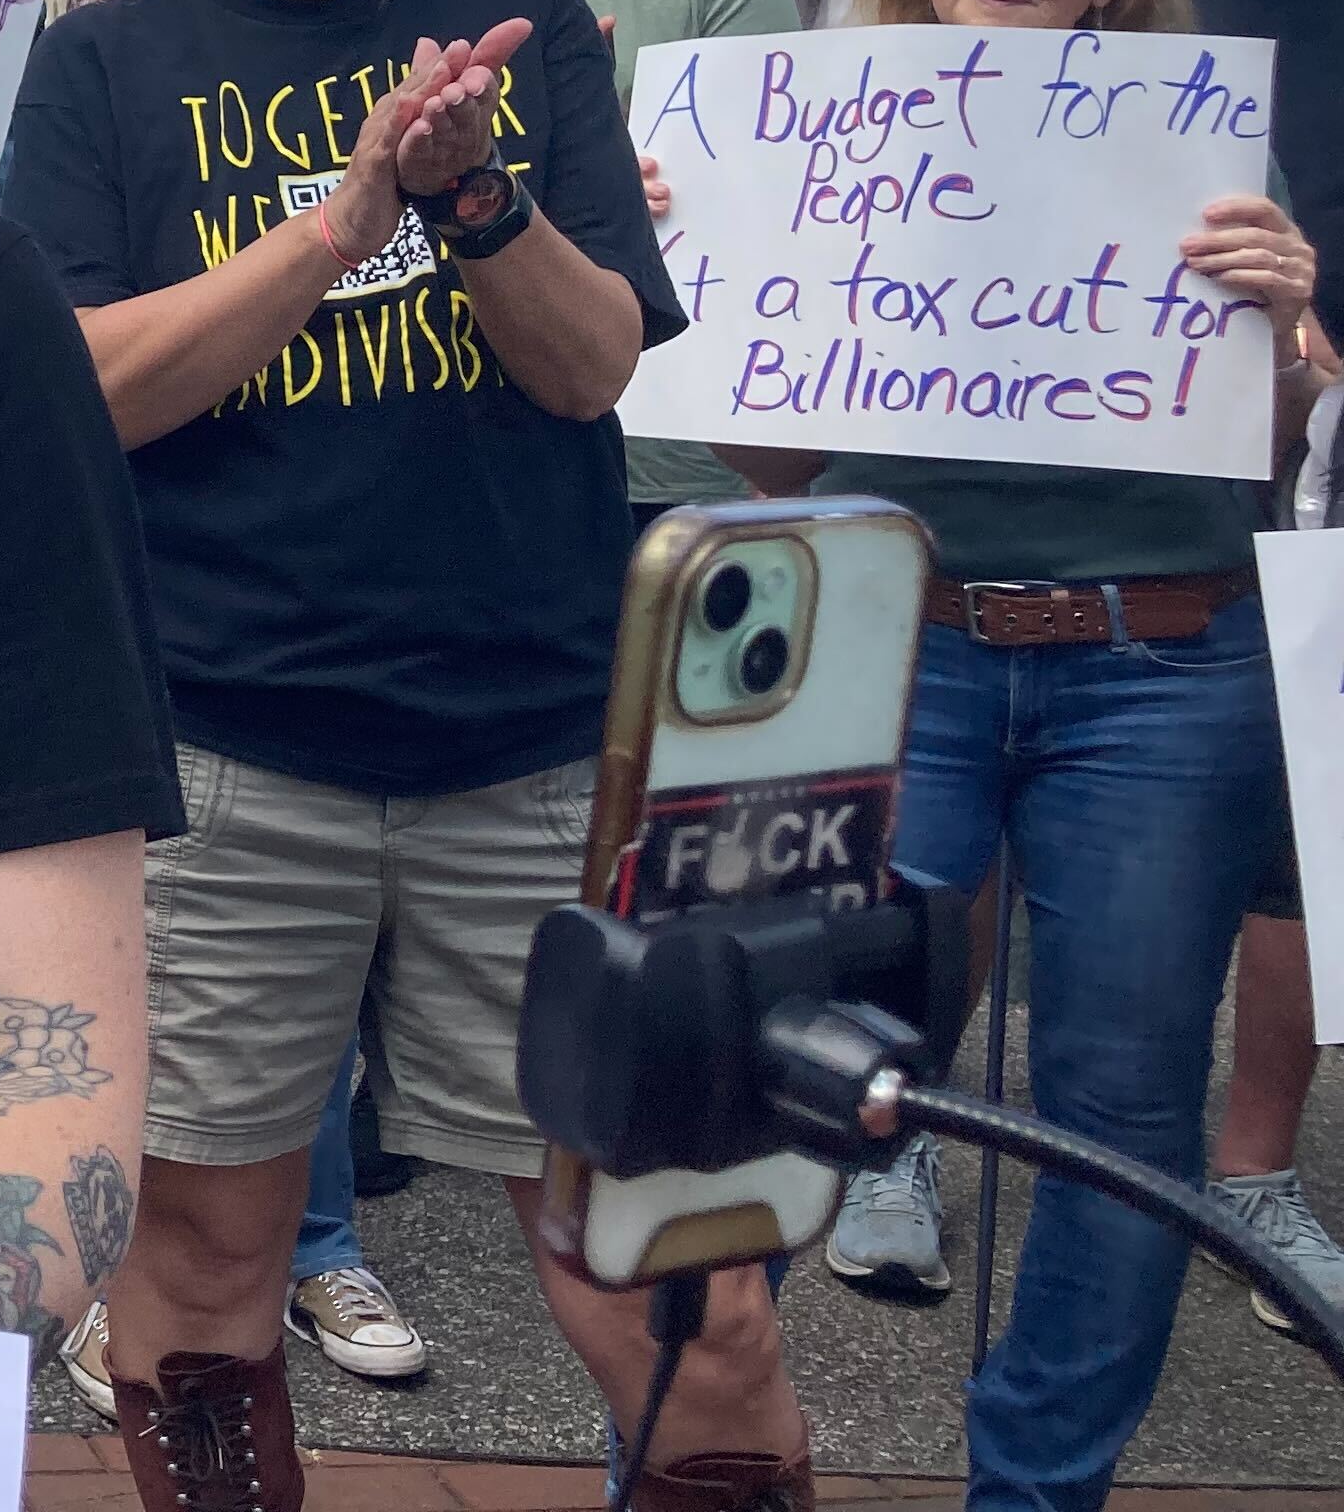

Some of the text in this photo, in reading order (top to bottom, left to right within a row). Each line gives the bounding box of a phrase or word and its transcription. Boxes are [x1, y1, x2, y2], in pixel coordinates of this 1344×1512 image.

[181, 58, 527, 182] TOGETR
[643, 32, 1270, 165] A Budget for the
[791, 139, 997, 241] People
[755, 275, 800, 322] a
[831, 243, 954, 336] tax
[971, 243, 1128, 334] cut
[1144, 258, 1263, 340] for
[731, 338, 1201, 422] Billionaires!
[666, 805, 857, 891] FCK
